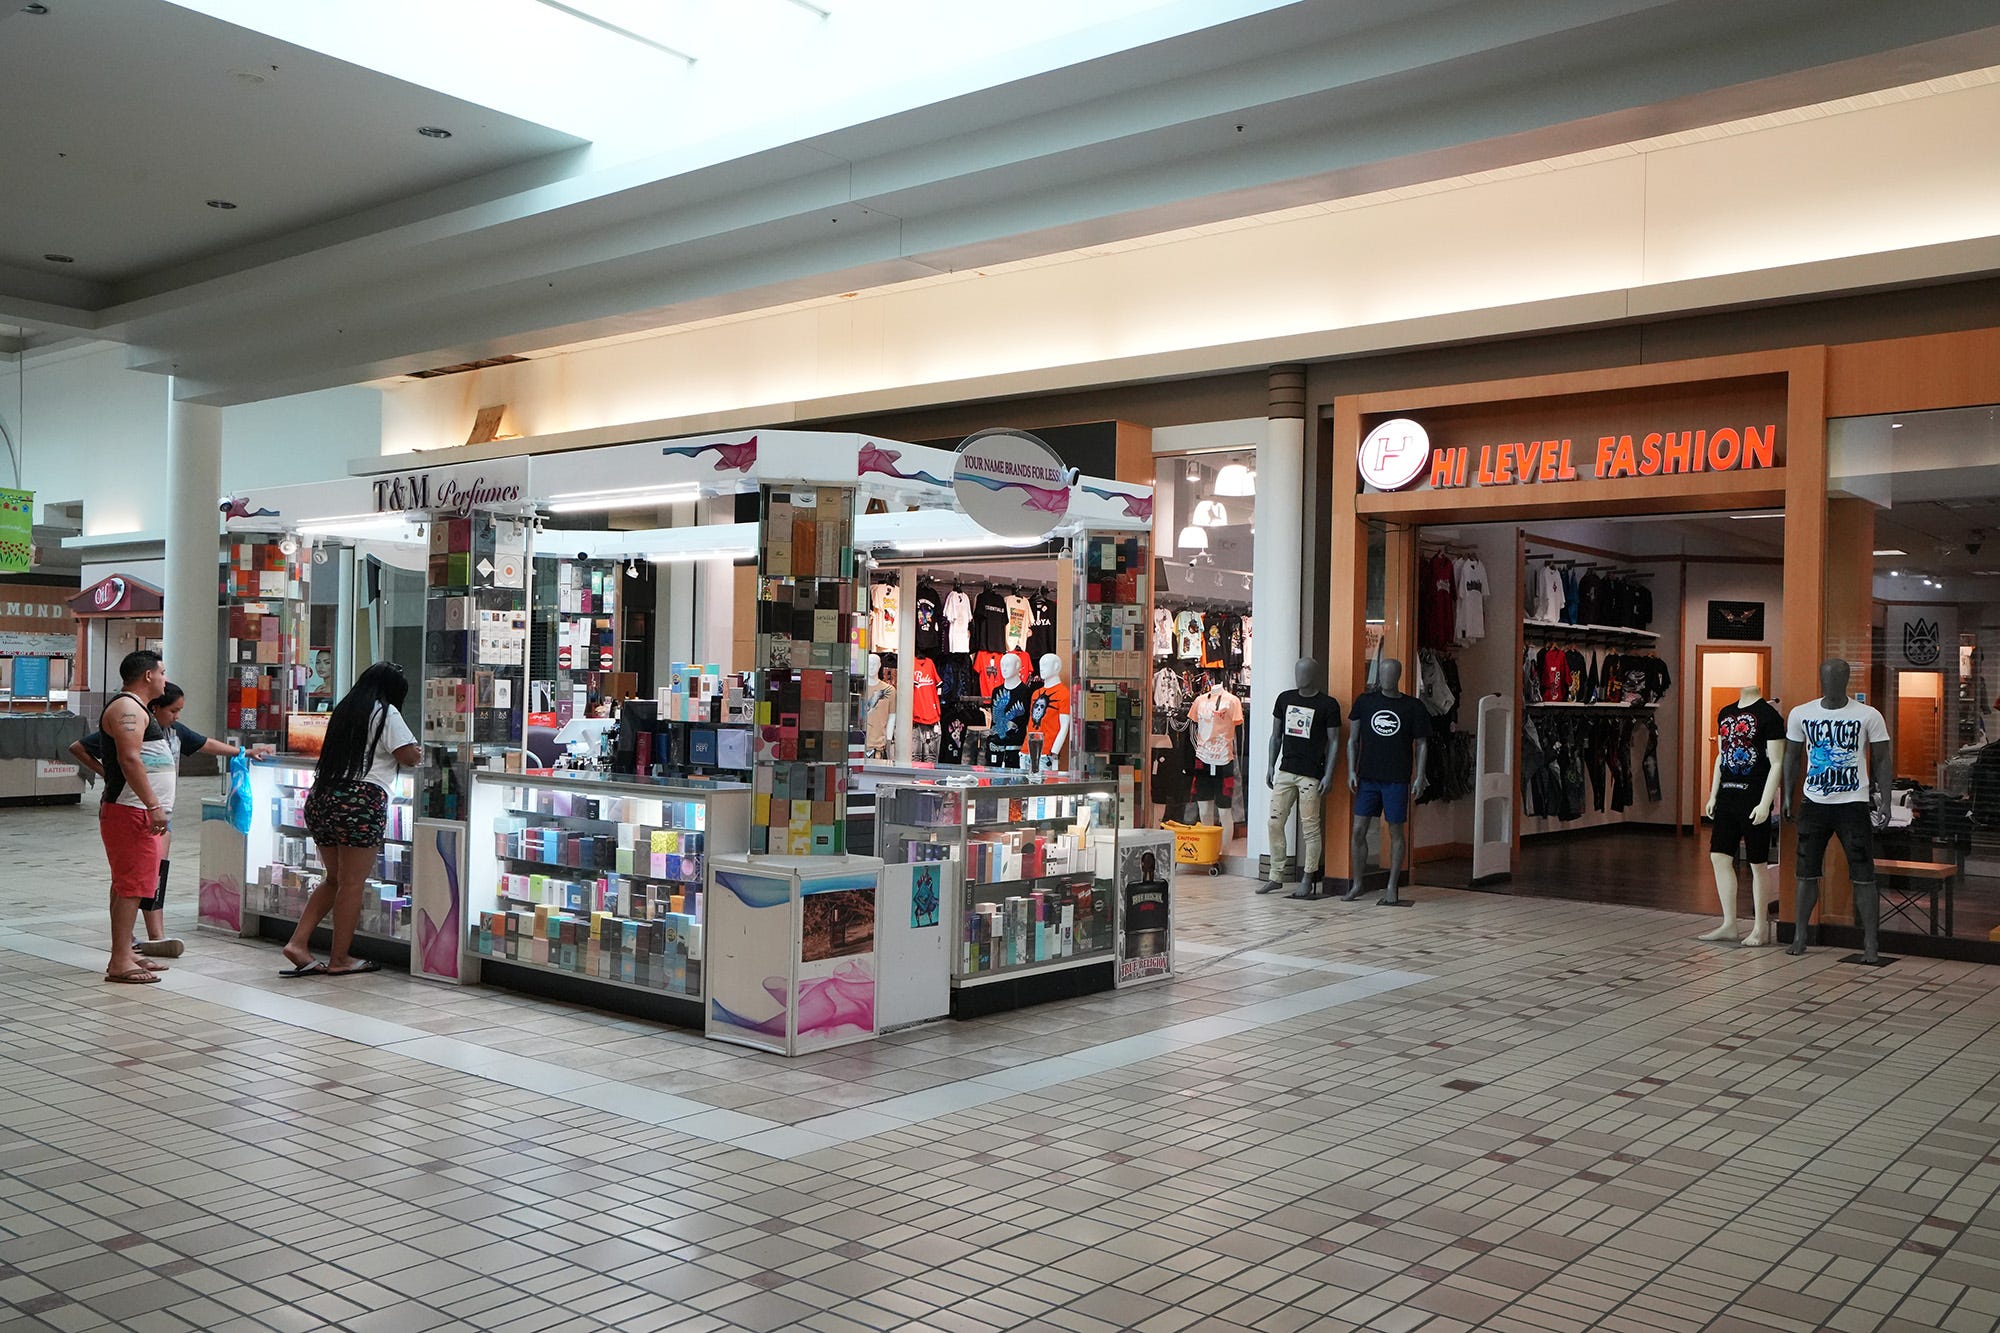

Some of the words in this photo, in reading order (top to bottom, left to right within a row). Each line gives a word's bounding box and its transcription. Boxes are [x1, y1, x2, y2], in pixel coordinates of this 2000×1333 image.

[964, 455, 983, 470] YOUR
[984, 459, 1004, 474] NAME
[1005, 461, 1031, 478] BRANDS
[1032, 467, 1044, 480] FOR
[1430, 446, 1467, 487] HI
[1478, 439, 1576, 486] LEVEL
[1594, 425, 1776, 478] FASHION
[373, 474, 430, 513] T&M
[435, 477, 520, 519] Perfumes
[0, 602, 63, 619] MOND
[1802, 719, 1862, 752] NEVER
[43, 766, 76, 774] BATTERIES
[1138, 956, 1168, 969] RELIGION
